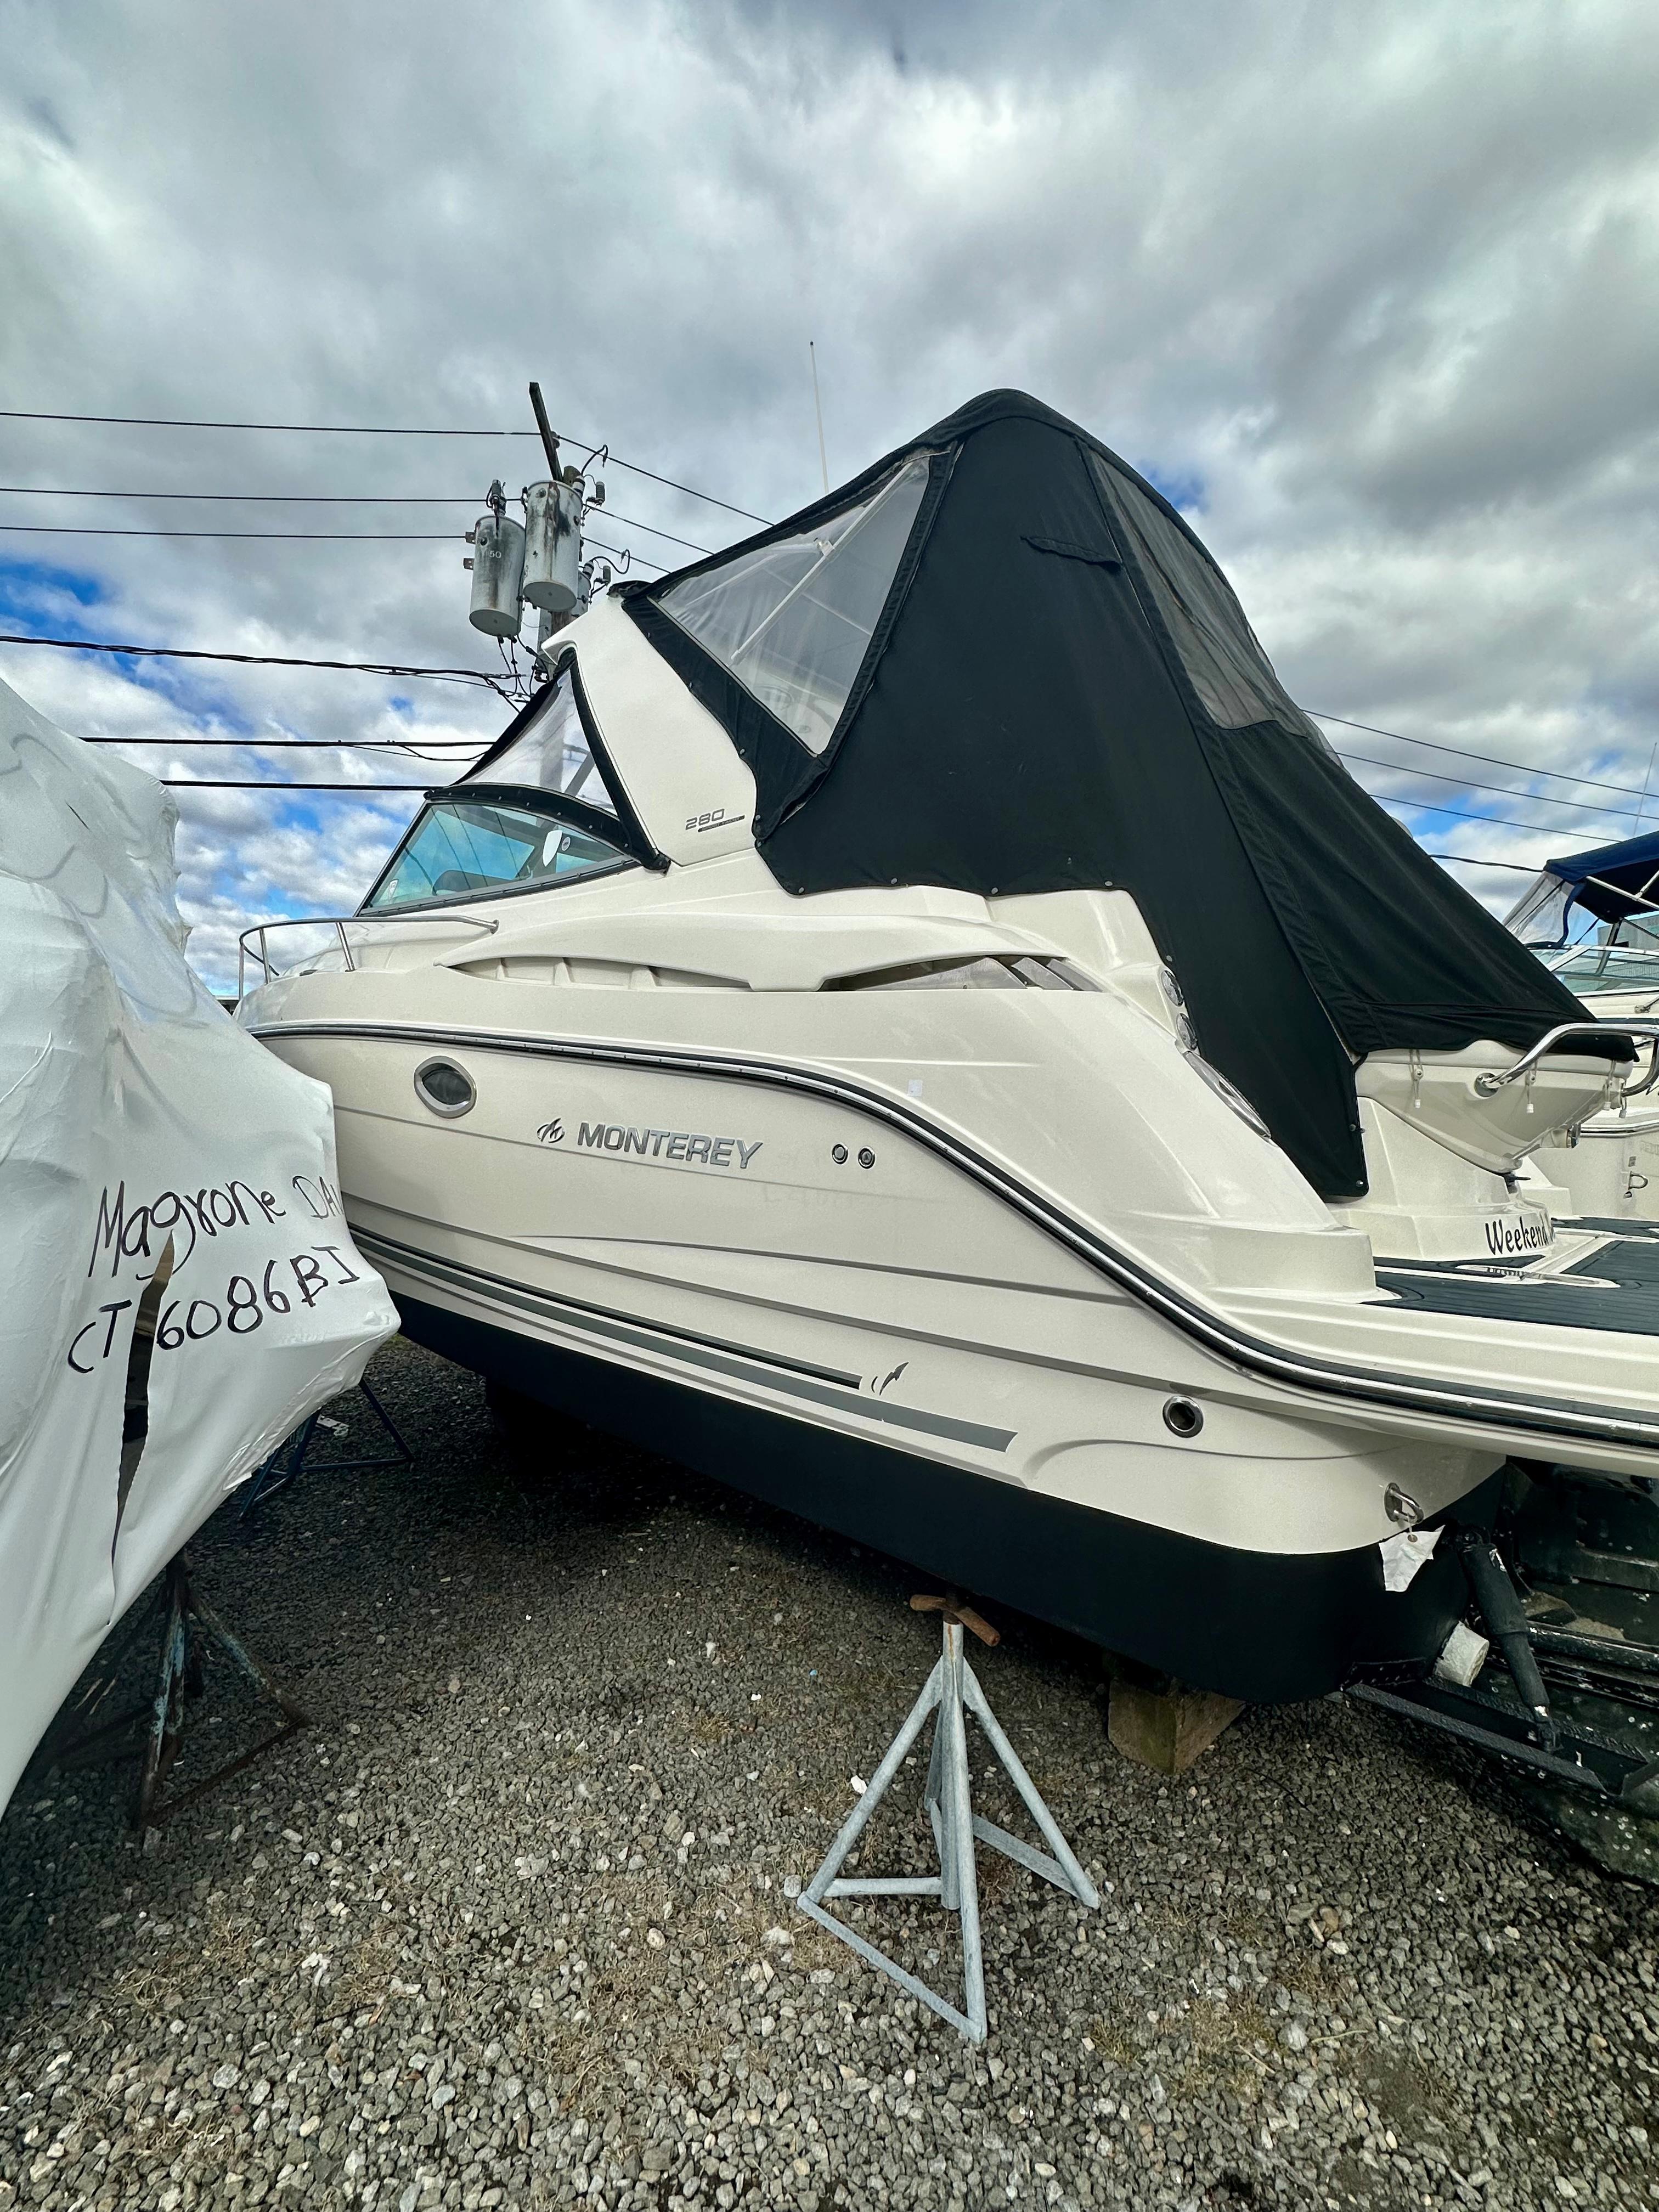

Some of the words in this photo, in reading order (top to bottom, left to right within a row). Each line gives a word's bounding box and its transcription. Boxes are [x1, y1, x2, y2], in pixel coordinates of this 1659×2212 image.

[489, 550, 501, 558] 50
[686, 809, 724, 830] 280
[577, 1122, 763, 1169] MONTEREY
[67, 1299, 132, 1374] CT
